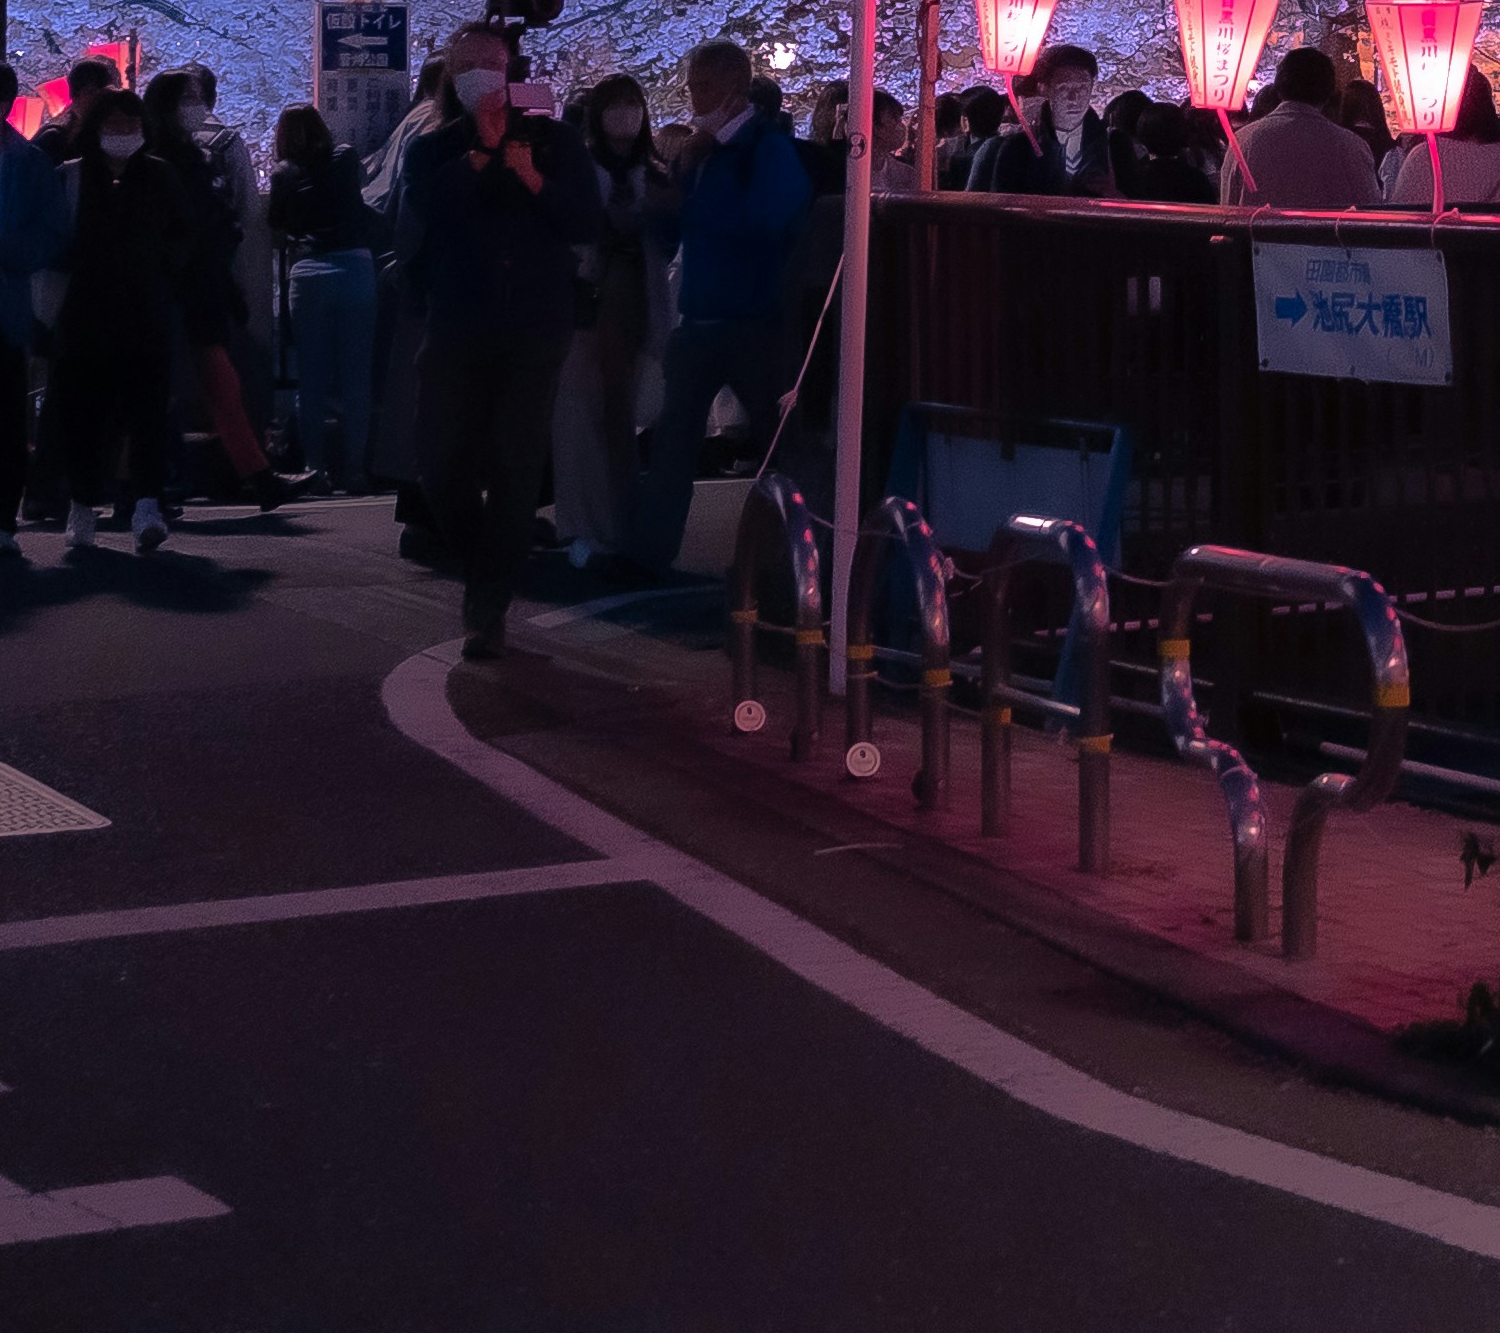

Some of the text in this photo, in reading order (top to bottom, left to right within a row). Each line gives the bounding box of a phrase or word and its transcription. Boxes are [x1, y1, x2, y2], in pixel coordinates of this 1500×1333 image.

[1309, 289, 1432, 339] 池尻大橋駅
